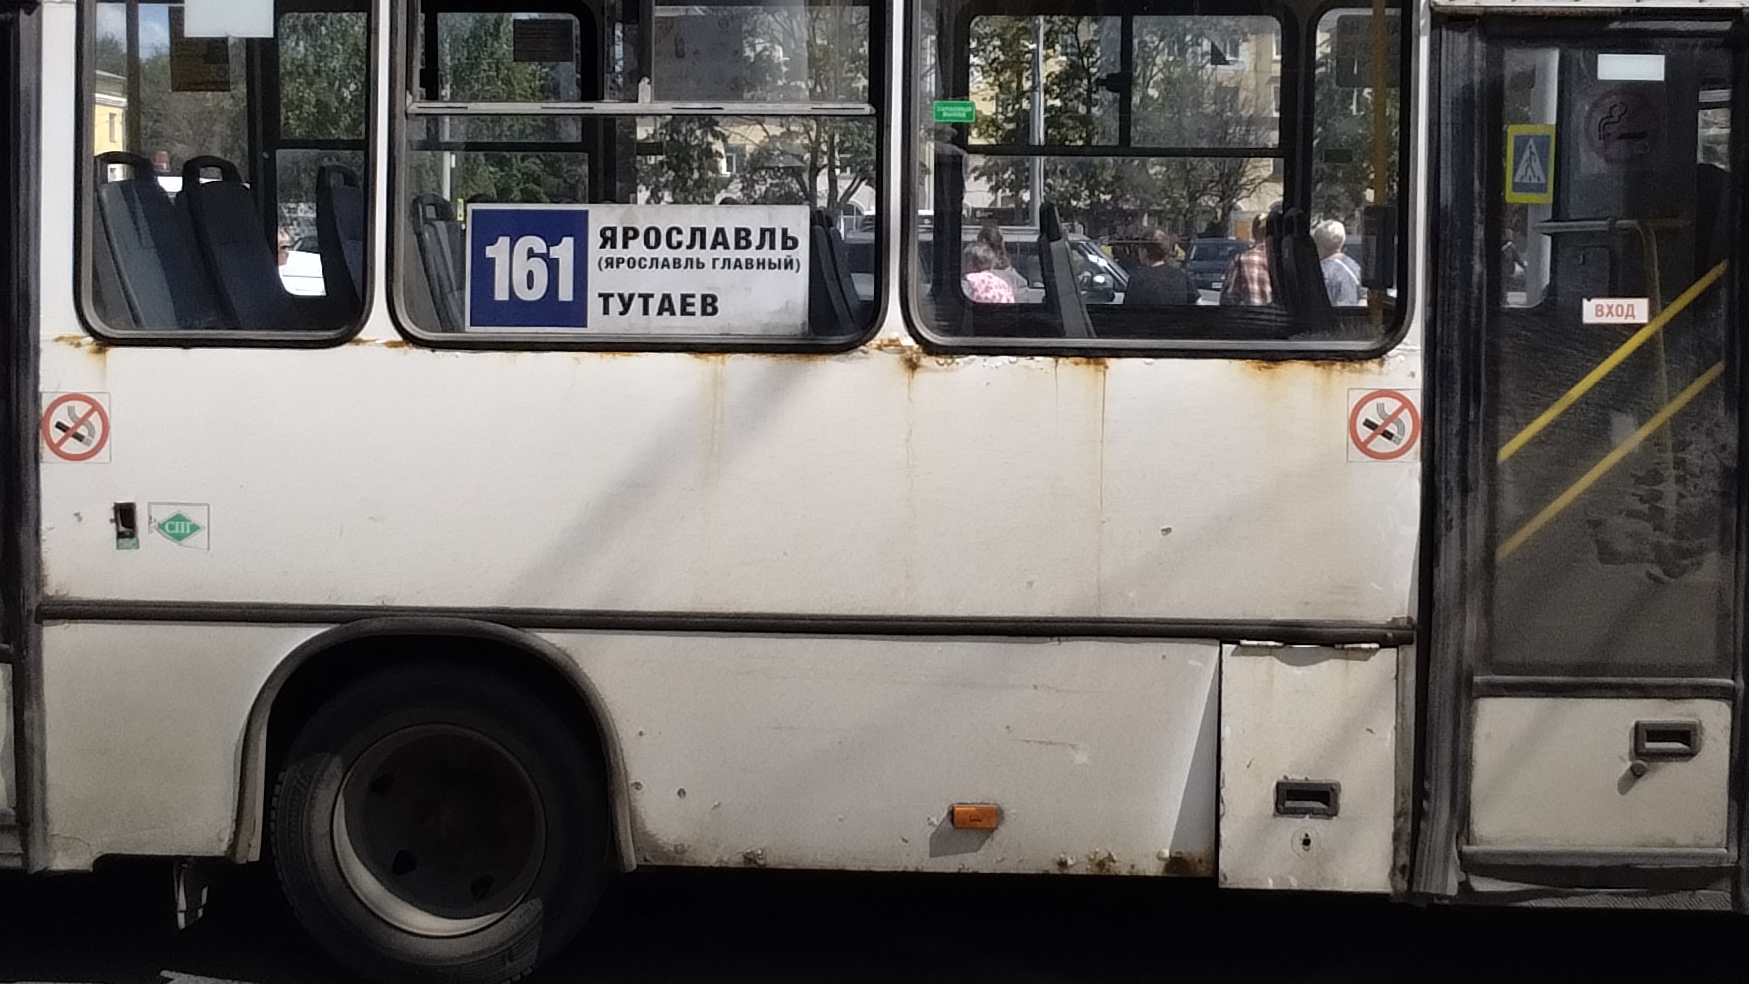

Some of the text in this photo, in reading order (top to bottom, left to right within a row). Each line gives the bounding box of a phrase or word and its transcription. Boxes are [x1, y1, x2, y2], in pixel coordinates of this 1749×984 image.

[599, 226, 800, 250] ЯРОСЛАВЛЬ
[485, 236, 574, 302] 161
[597, 255, 801, 273] (ЯРОСЛАВЛЬ ГЛАВНЫЙ)
[598, 293, 719, 317] ТУТАЕВ
[1595, 304, 1636, 320] ВХОД
